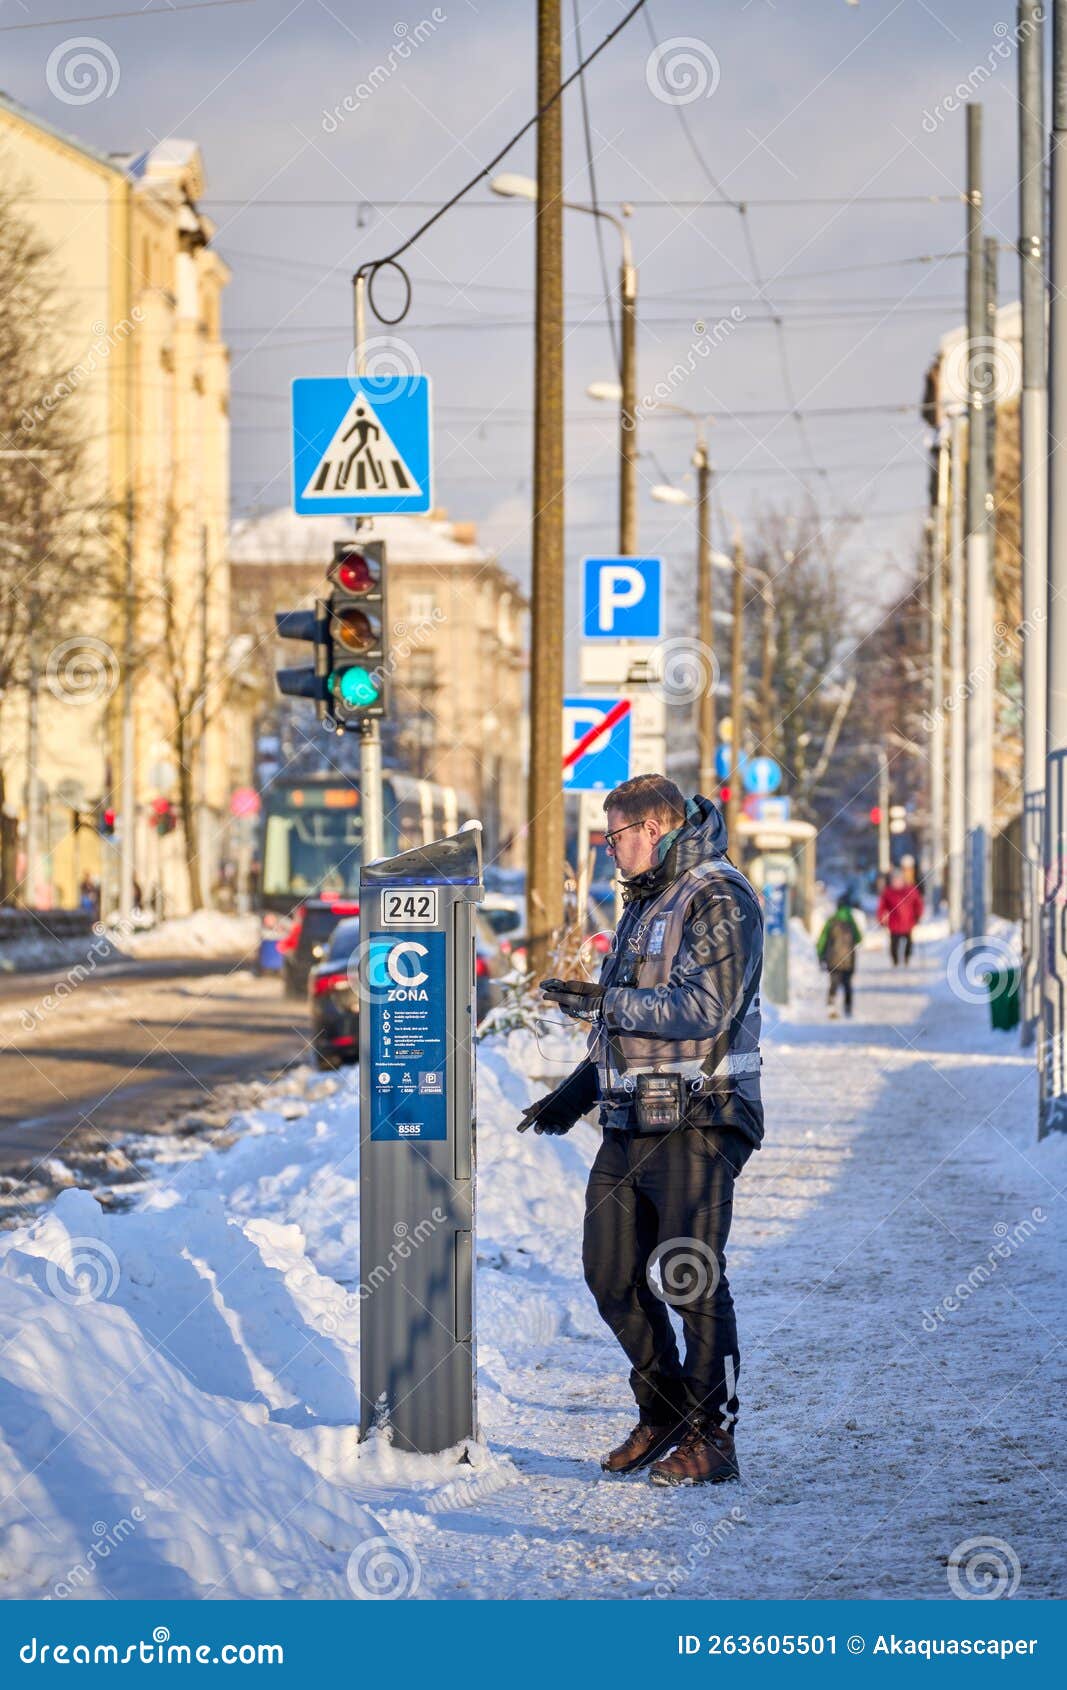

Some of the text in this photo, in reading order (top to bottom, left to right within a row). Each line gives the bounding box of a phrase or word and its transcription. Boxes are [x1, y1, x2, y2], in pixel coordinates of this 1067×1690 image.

[599, 566, 646, 631] P
[563, 707, 611, 782] P
[389, 897, 430, 917] 242
[388, 942, 429, 986] C
[388, 990, 429, 1001] ZONA
[398, 1125, 421, 1134] 8585
